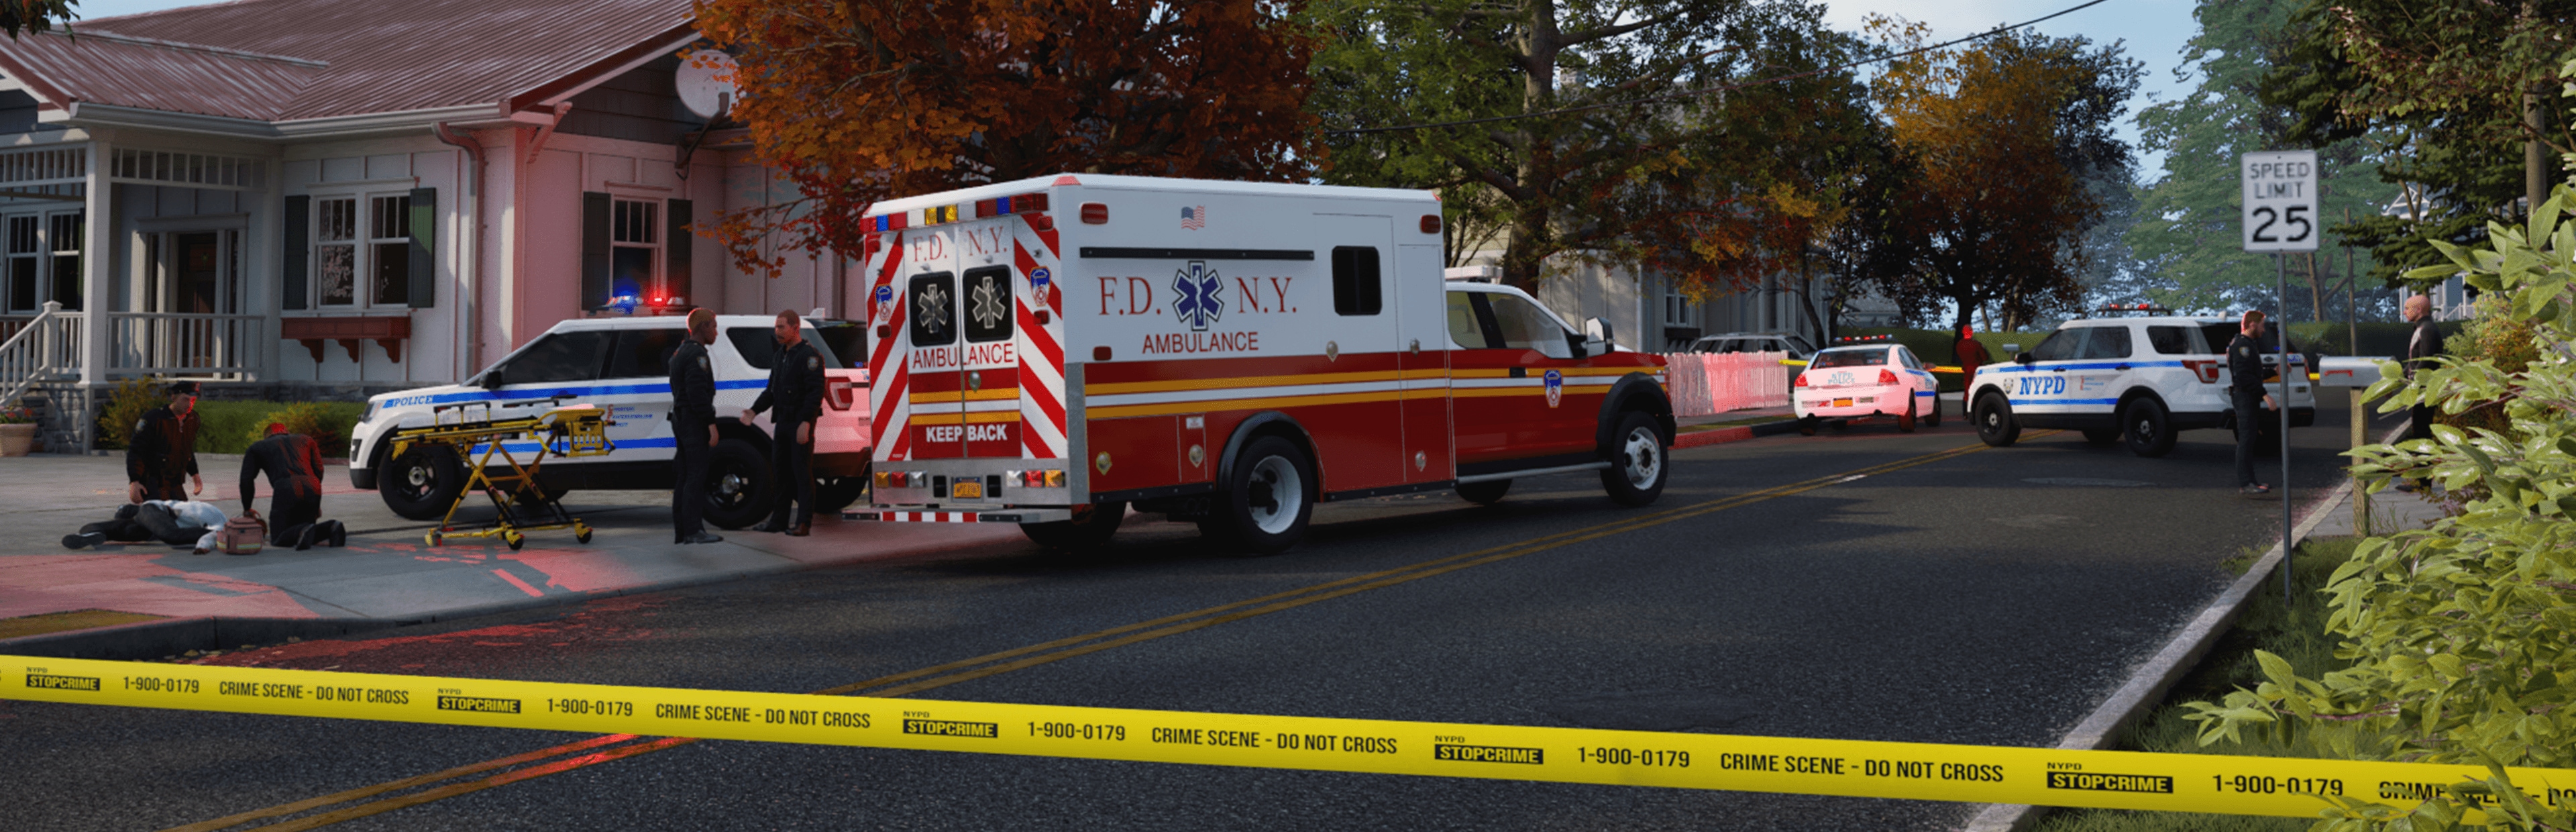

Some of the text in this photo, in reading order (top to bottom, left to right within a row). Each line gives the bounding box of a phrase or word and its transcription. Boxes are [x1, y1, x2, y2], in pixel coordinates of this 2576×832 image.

[2250, 162, 2310, 179] SPEED
[2254, 182, 2304, 199] LIMIT
[2252, 206, 2311, 242] 25
[913, 226, 1007, 262] F.D. N.Y.
[1097, 276, 1297, 315] F.D. N.Y.
[1142, 331, 1259, 354] AMBULANCE
[912, 343, 1014, 369] AMBULANCE
[2019, 376, 2065, 395] NYPD
[394, 395, 433, 407] POLICE
[926, 424, 1008, 443] KEEP BACK
[29, 675, 98, 690] STOPCRIME
[124, 676, 199, 693] 1-900-0179
[219, 680, 259, 696] CRIME
[263, 684, 303, 699] SCENE
[316, 686, 333, 700] DO
[337, 687, 362, 703] NOT
[367, 689, 409, 705] CROSS
[440, 696, 519, 713] STOPCRIME
[547, 698, 633, 717] 1-900-0179
[656, 703, 700, 720] CRIME
[704, 706, 751, 723] SCENE
[765, 708, 786, 725] DO
[790, 710, 818, 726] NOT
[823, 711, 871, 729] CROSS
[907, 720, 994, 737] STOPCRIME
[1028, 722, 1125, 741] 1-900-0179
[1152, 727, 1203, 745] CRIME
[1208, 730, 1260, 748] SCENE
[1277, 733, 1299, 750] DO
[1304, 734, 1337, 751] NOT
[1342, 736, 1397, 755] CROSS
[1439, 745, 1540, 764] STOPCRIME
[1577, 747, 1690, 768] 1-900-0179
[1720, 752, 1779, 772] CRIME
[1784, 756, 1845, 776] SCENE
[1865, 759, 1891, 778] DO
[1896, 761, 1935, 780] NOT
[1941, 763, 2004, 783] CROSS
[2047, 762, 2082, 771] NYPD
[2053, 774, 2168, 793] STOPCRIME
[2212, 774, 2343, 796] 1-900-0179
